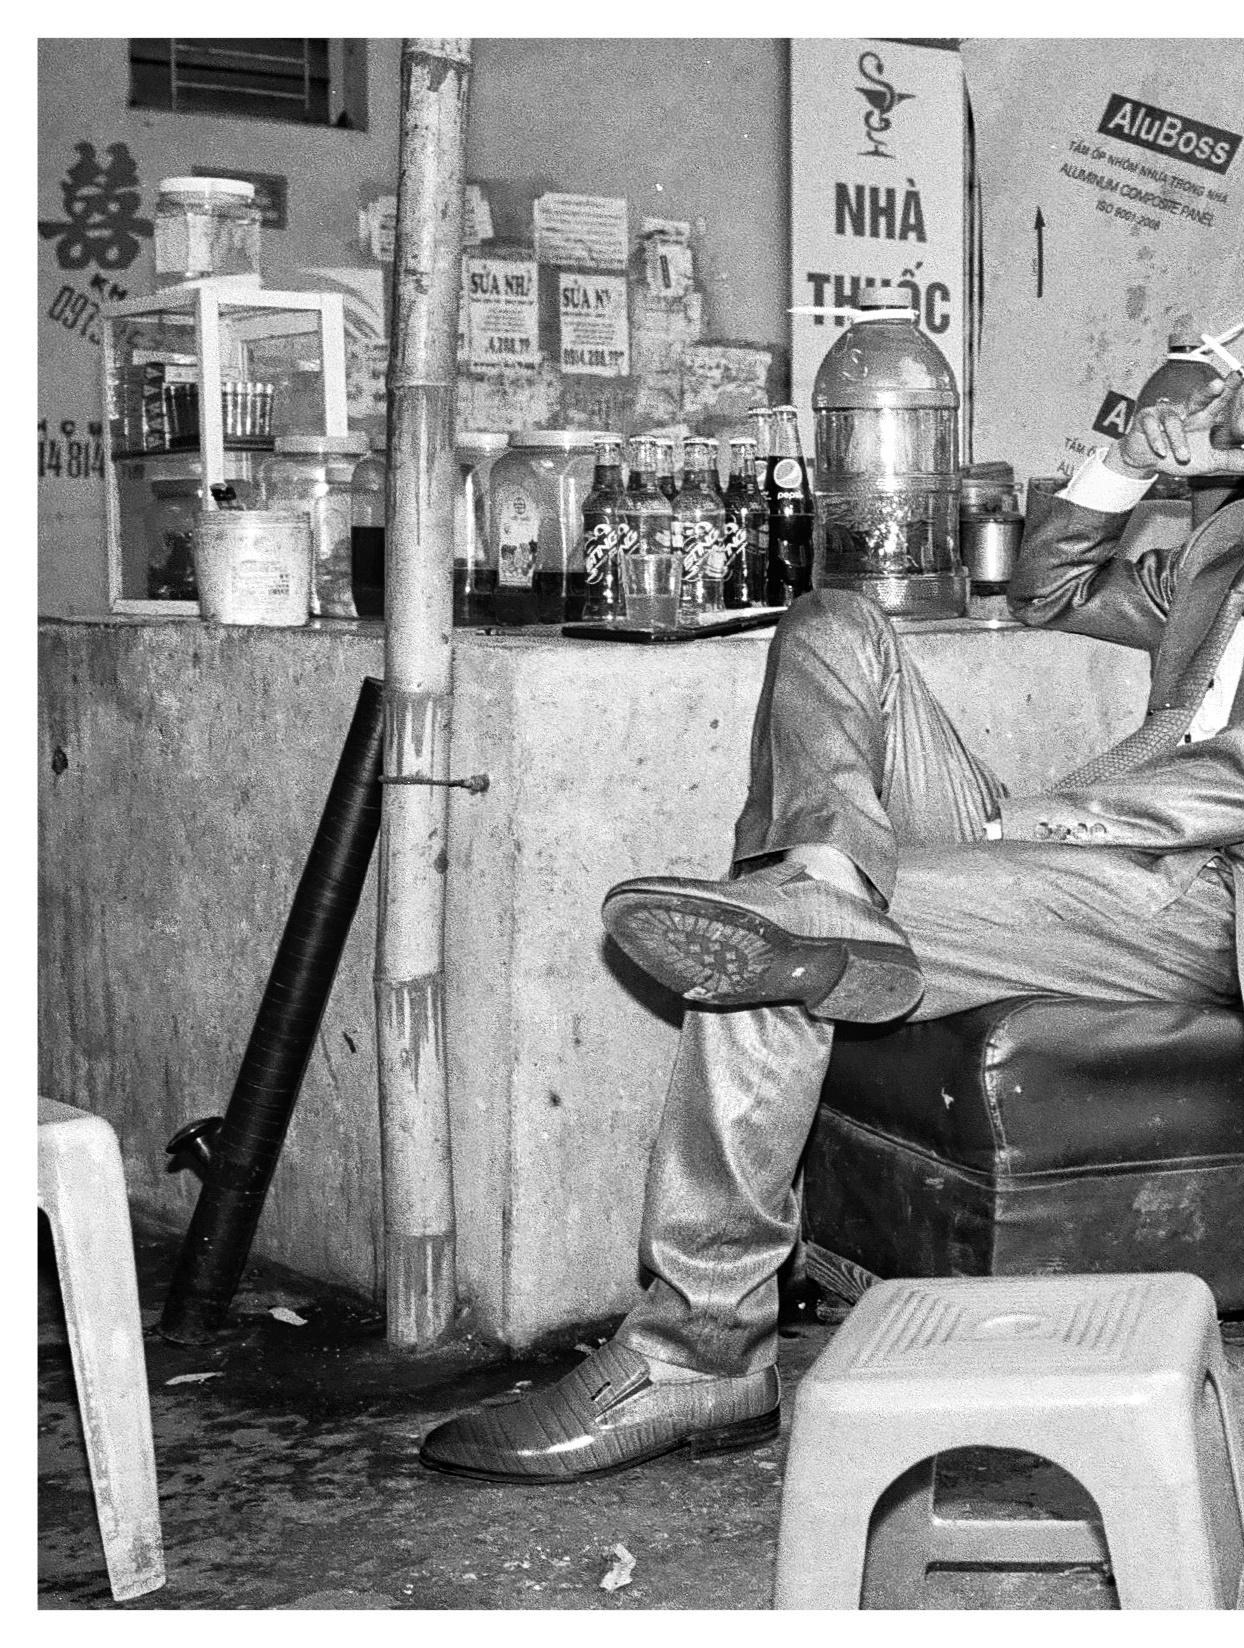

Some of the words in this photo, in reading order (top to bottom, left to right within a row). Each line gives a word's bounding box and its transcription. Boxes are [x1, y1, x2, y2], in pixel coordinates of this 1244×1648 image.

[1108, 103, 1231, 165] AluBoss
[835, 177, 927, 243] NHÀ
[1180, 205, 1214, 227] PANEL
[807, 261, 951, 334] THỐC
